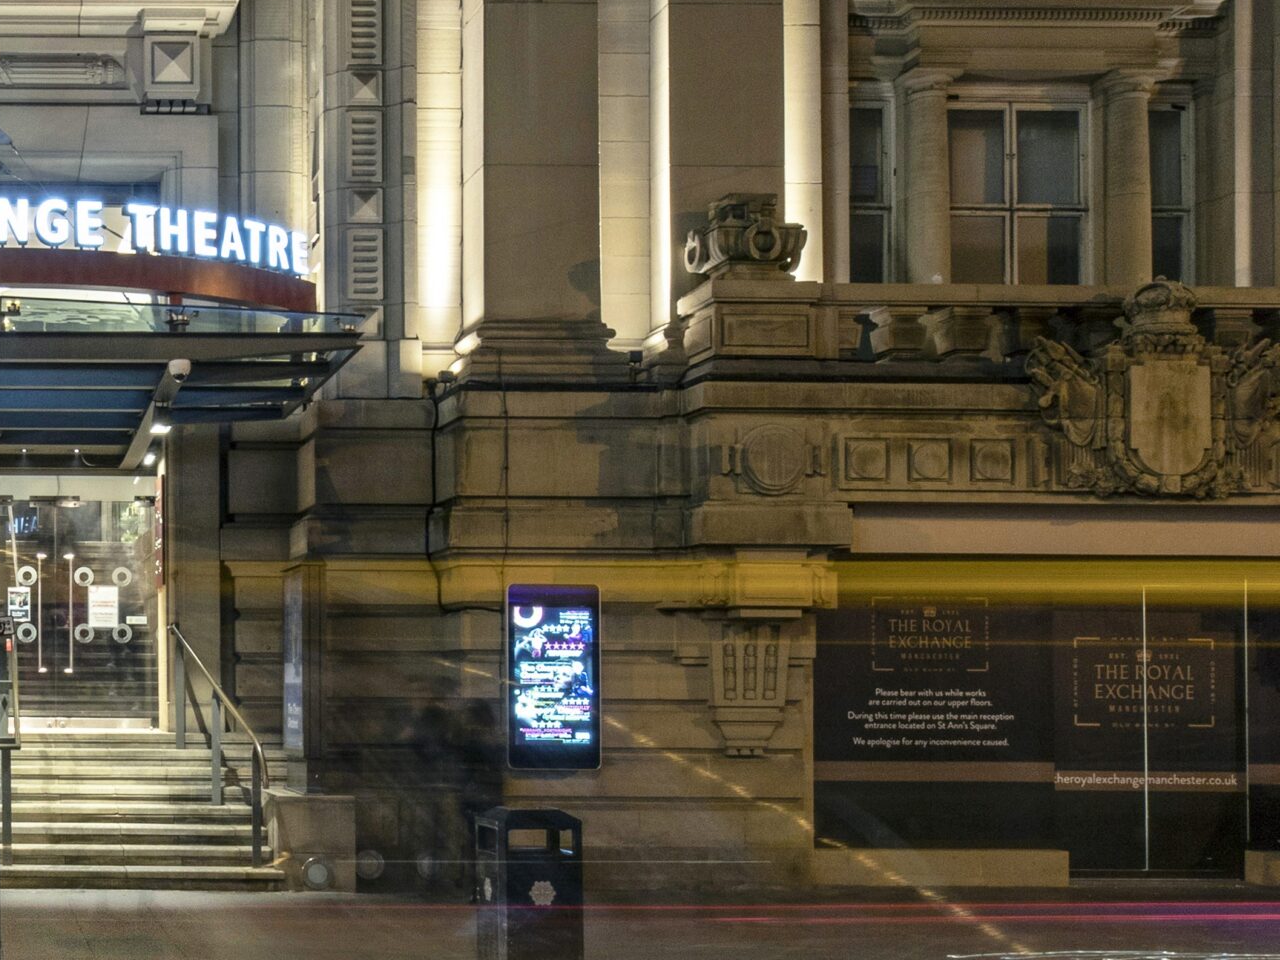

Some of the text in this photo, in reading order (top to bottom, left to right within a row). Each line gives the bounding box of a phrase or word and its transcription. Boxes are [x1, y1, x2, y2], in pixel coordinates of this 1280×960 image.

[127, 202, 310, 275] THEATRE
[888, 618, 972, 633] THE ROYAL
[888, 635, 972, 648] EXCHANGE
[1094, 664, 1194, 681] THE ROYAL
[875, 688, 899, 697] Please
[900, 688, 917, 697] bear
[918, 688, 934, 697] with
[945, 688, 964, 697] while
[965, 689, 987, 697] works
[1094, 684, 1195, 700] EXCHANGE
[882, 698, 907, 706] carried
[970, 699, 993, 707] floors.
[847, 711, 874, 721] During
[874, 712, 889, 720] this
[889, 712, 907, 720] time
[907, 712, 931, 722] please
[946, 712, 959, 720] the
[979, 713, 1015, 722] reception
[898, 721, 925, 729] located
[937, 721, 946, 730] St
[970, 721, 997, 732] Square.
[852, 737, 1010, 748] We apologise for any inconvenience caused.
